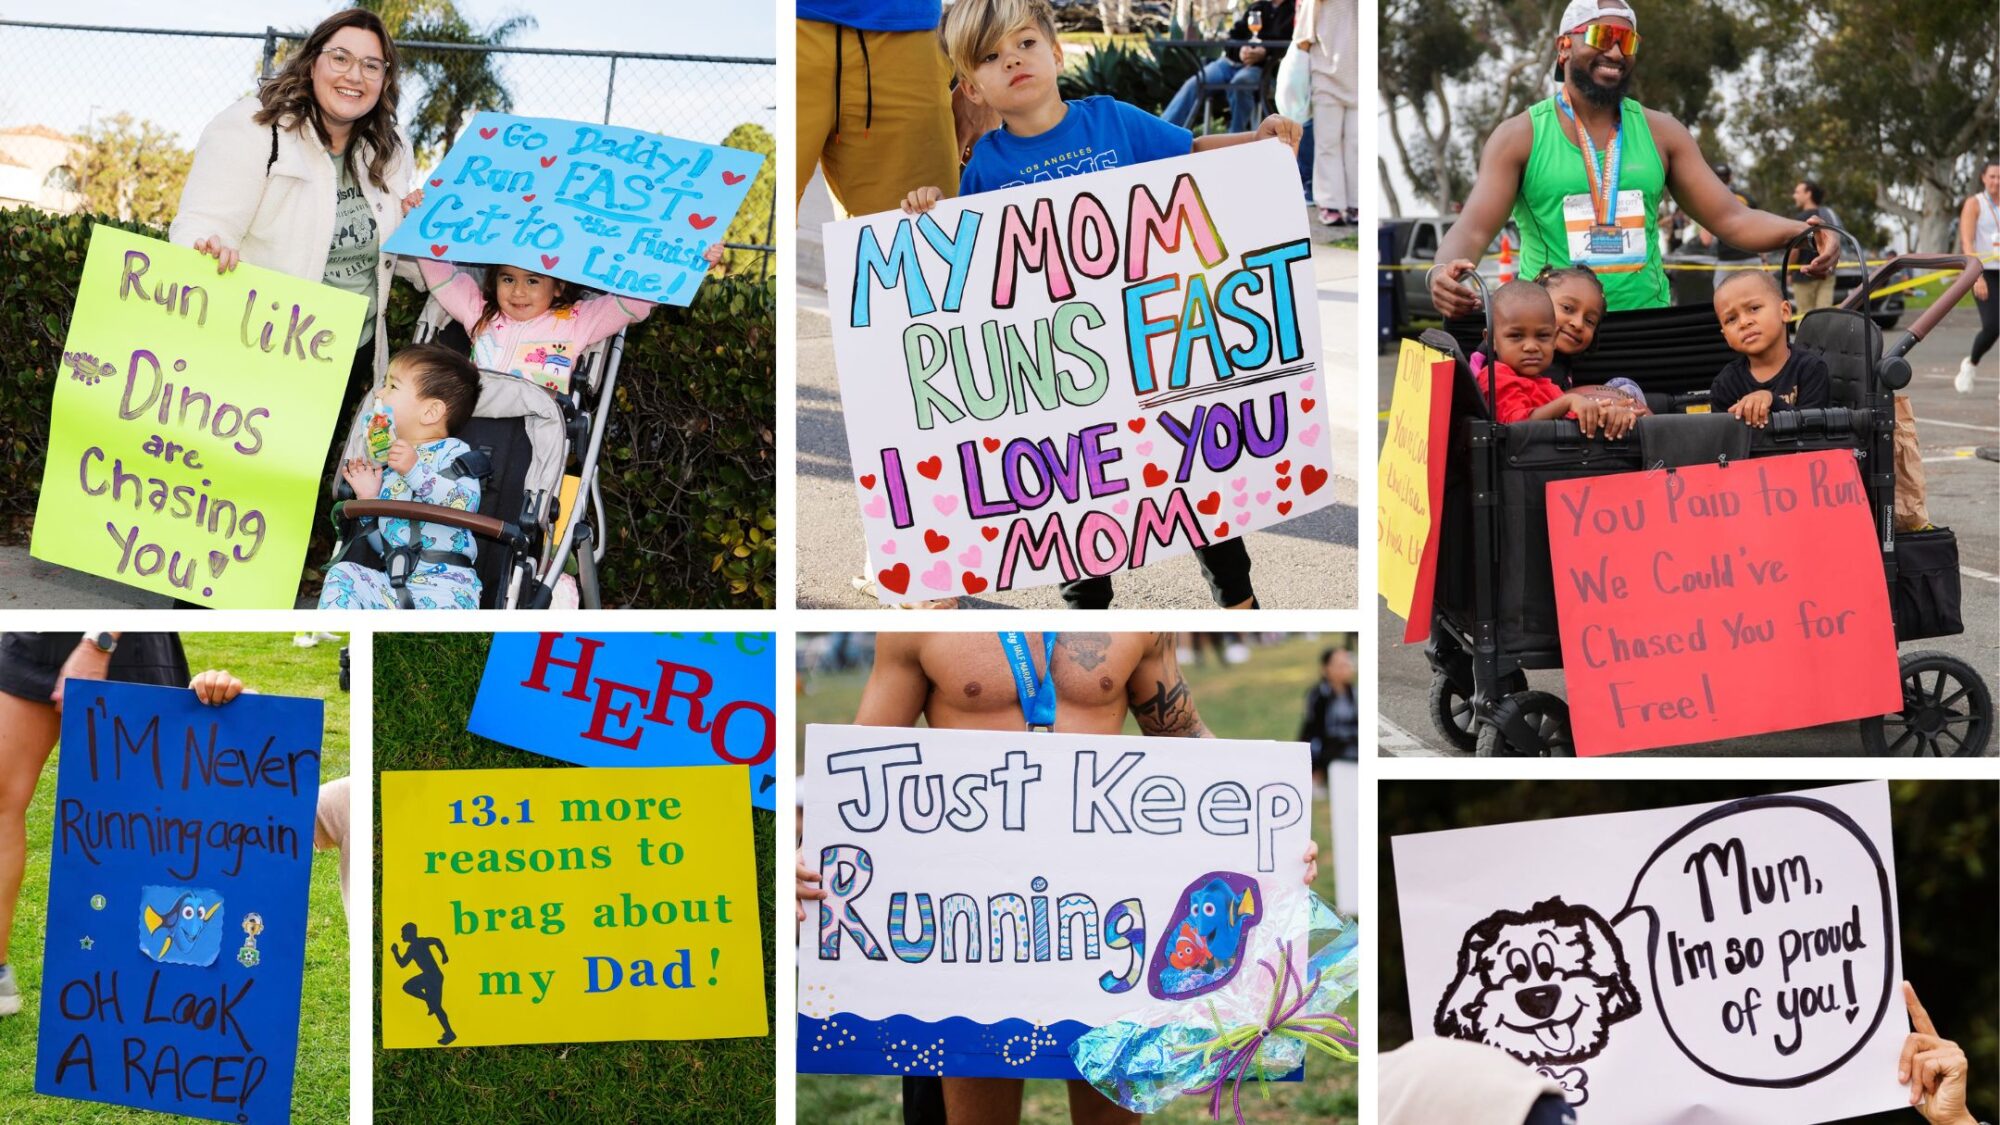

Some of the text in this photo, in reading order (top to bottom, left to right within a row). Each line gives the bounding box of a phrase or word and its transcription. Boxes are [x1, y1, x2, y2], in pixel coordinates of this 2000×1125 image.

[453, 155, 704, 221] Run FAST
[502, 122, 714, 188] Go Daddy!
[1020, 147, 1093, 175] LOS ANGELES
[419, 194, 710, 273] Get to the Finish
[850, 172, 1229, 328] MY MOM
[119, 250, 337, 363] Run like
[582, 246, 687, 304] Line!
[902, 238, 1310, 430] RUNS FAST
[118, 349, 270, 455] Dinos
[142, 434, 204, 470] are
[880, 391, 1286, 529] I LOVE YOU
[79, 446, 267, 563] Chasing
[996, 487, 1210, 591] MOM
[1560, 486, 1645, 537] You
[1754, 466, 1798, 516] to
[106, 521, 230, 598] You!
[1570, 546, 1789, 604] We Could've
[1013, 644, 1026, 661] HALF
[1581, 600, 1856, 669] Chased You for
[520, 632, 776, 767] HERO
[1019, 661, 1036, 698] MARATHON
[1609, 673, 1718, 728] Free!
[86, 696, 165, 790] I'M
[62, 799, 298, 881] Running again
[448, 795, 682, 827] 13.1 more
[827, 742, 1303, 873] Just Keep
[424, 837, 684, 875] reasons to
[1683, 837, 1823, 923] Mum,
[449, 893, 733, 936] brag about
[817, 844, 1147, 994] Running
[1667, 904, 1867, 987] I'm so proud
[60, 970, 124, 1024] OH
[479, 969, 556, 1004] my
[1721, 959, 1860, 1056] of you!
[55, 1033, 267, 1123] A RACE!
